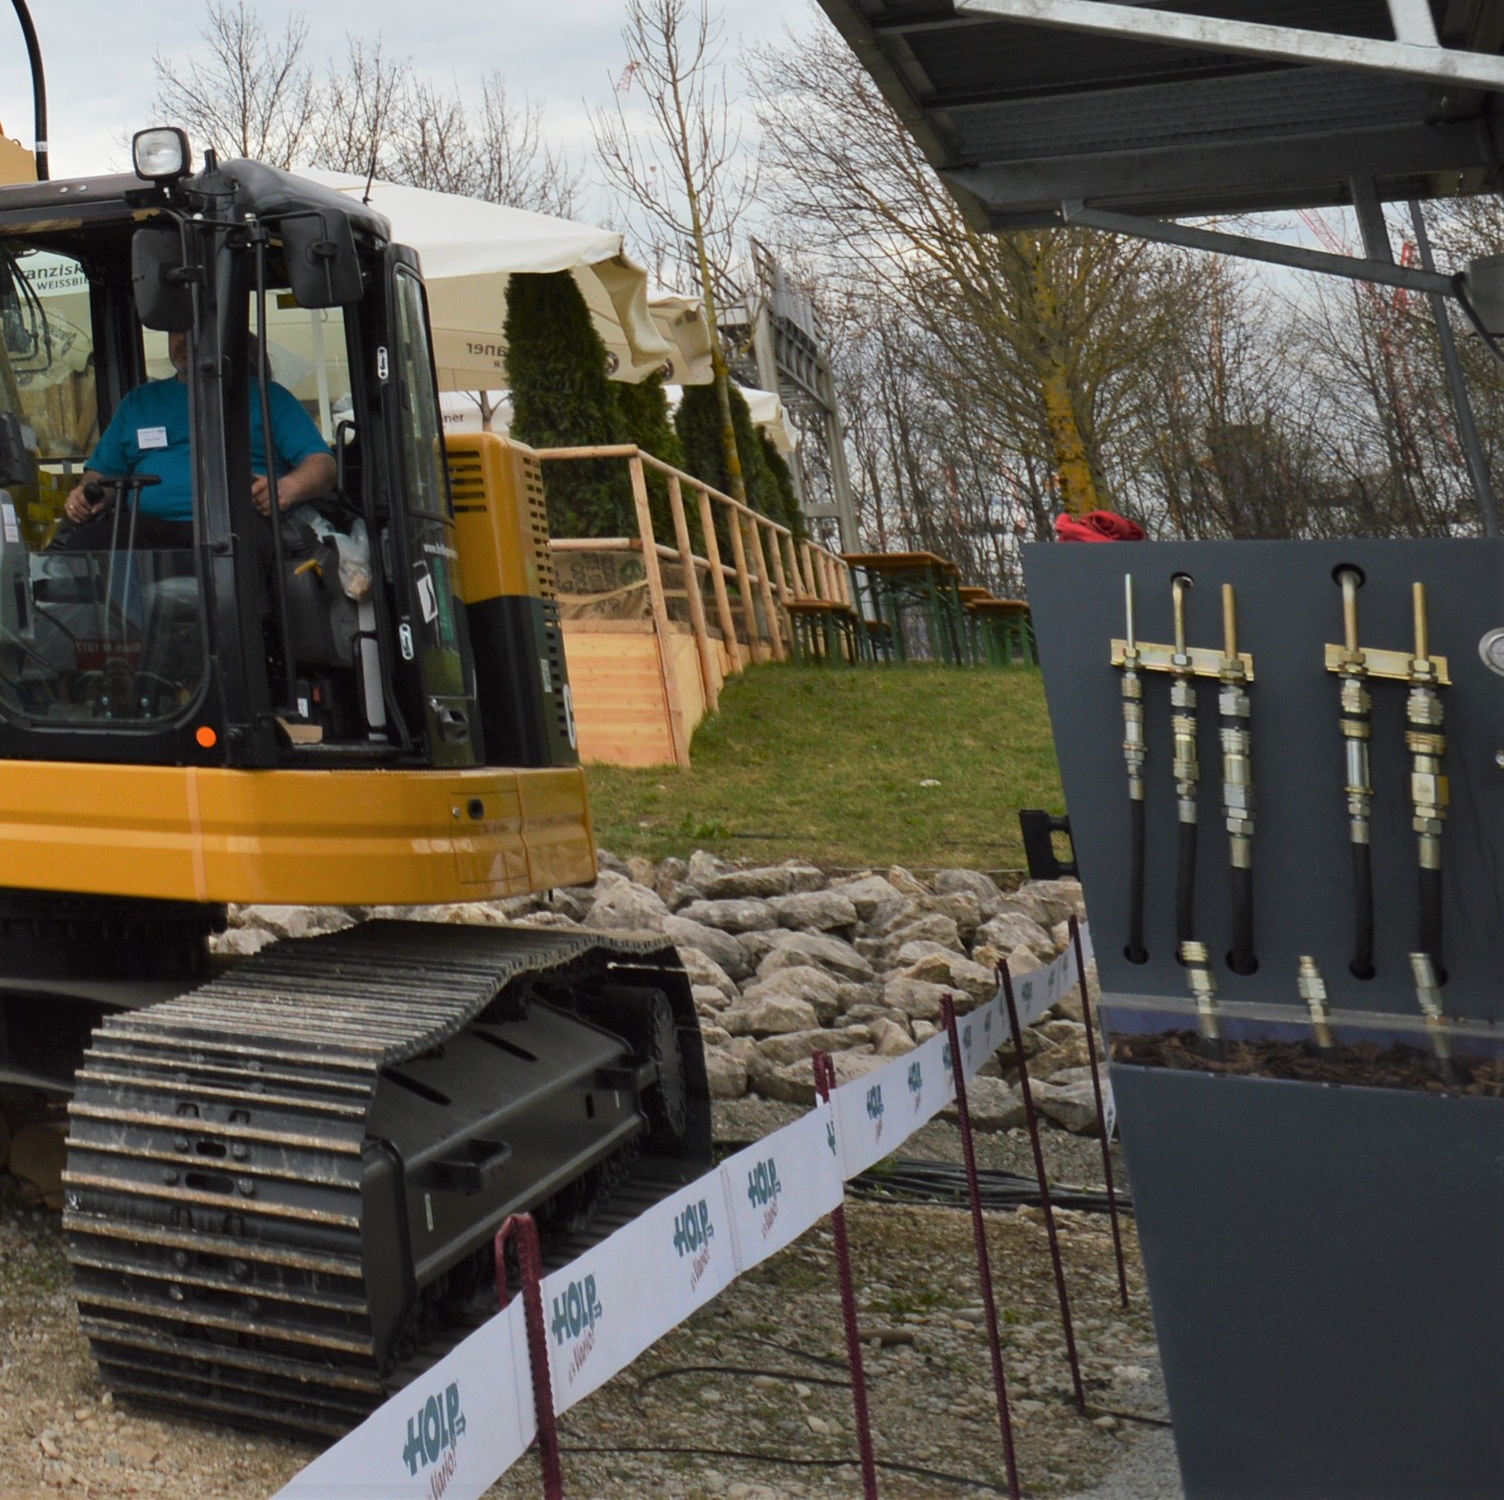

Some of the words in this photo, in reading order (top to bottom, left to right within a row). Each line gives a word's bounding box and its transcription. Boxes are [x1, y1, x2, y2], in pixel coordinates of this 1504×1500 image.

[673, 1199, 711, 1258] HOLP
[551, 1273, 599, 1347] HOLP
[402, 1382, 462, 1477] HOLP
